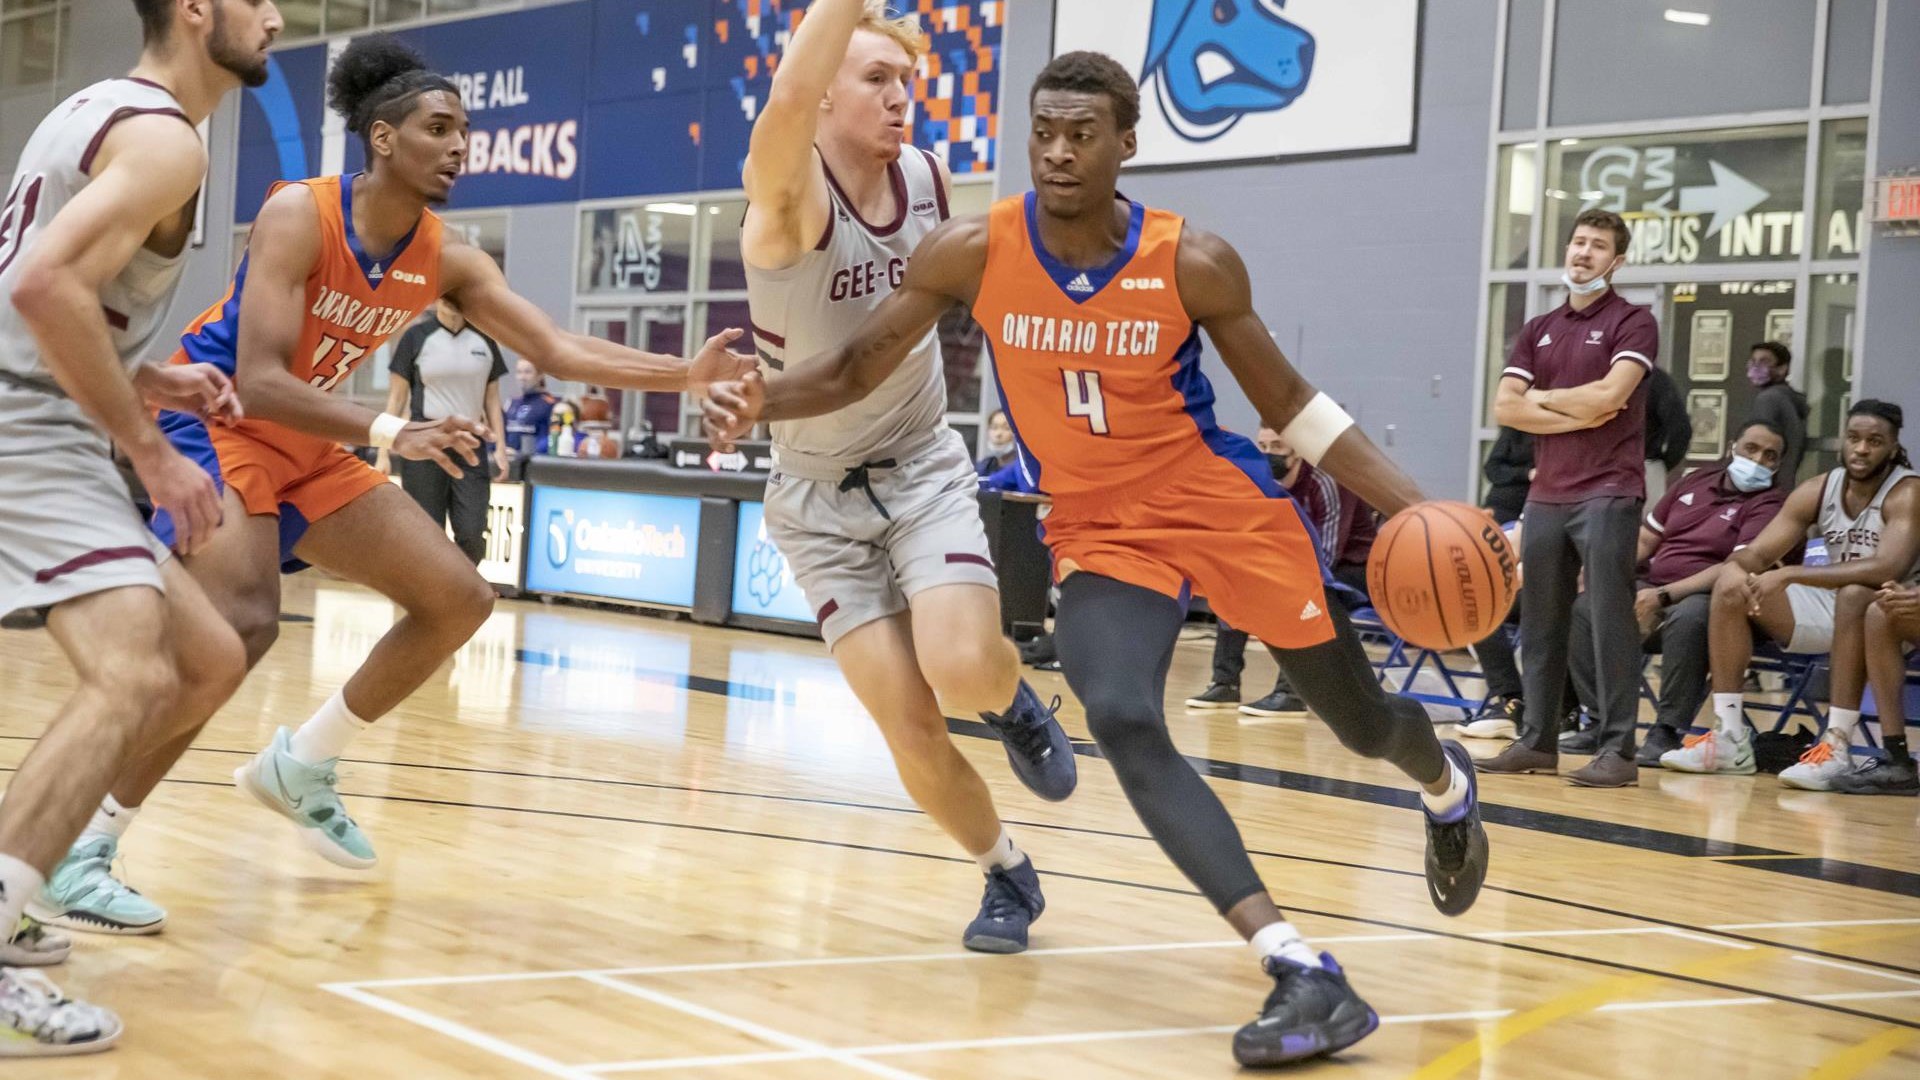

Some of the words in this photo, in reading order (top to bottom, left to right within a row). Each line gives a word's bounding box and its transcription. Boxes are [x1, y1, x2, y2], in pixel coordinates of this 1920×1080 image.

[489, 65, 529, 109] ALL
[459, 119, 577, 179] BACKS
[1624, 214, 1700, 264] MPUS
[829, 257, 910, 302] GEE-G
[1120, 277, 1165, 290] OUA
[1002, 312, 1097, 354] ONTARIO
[1105, 320, 1160, 356] TECH
[1060, 367, 1110, 435] 4
